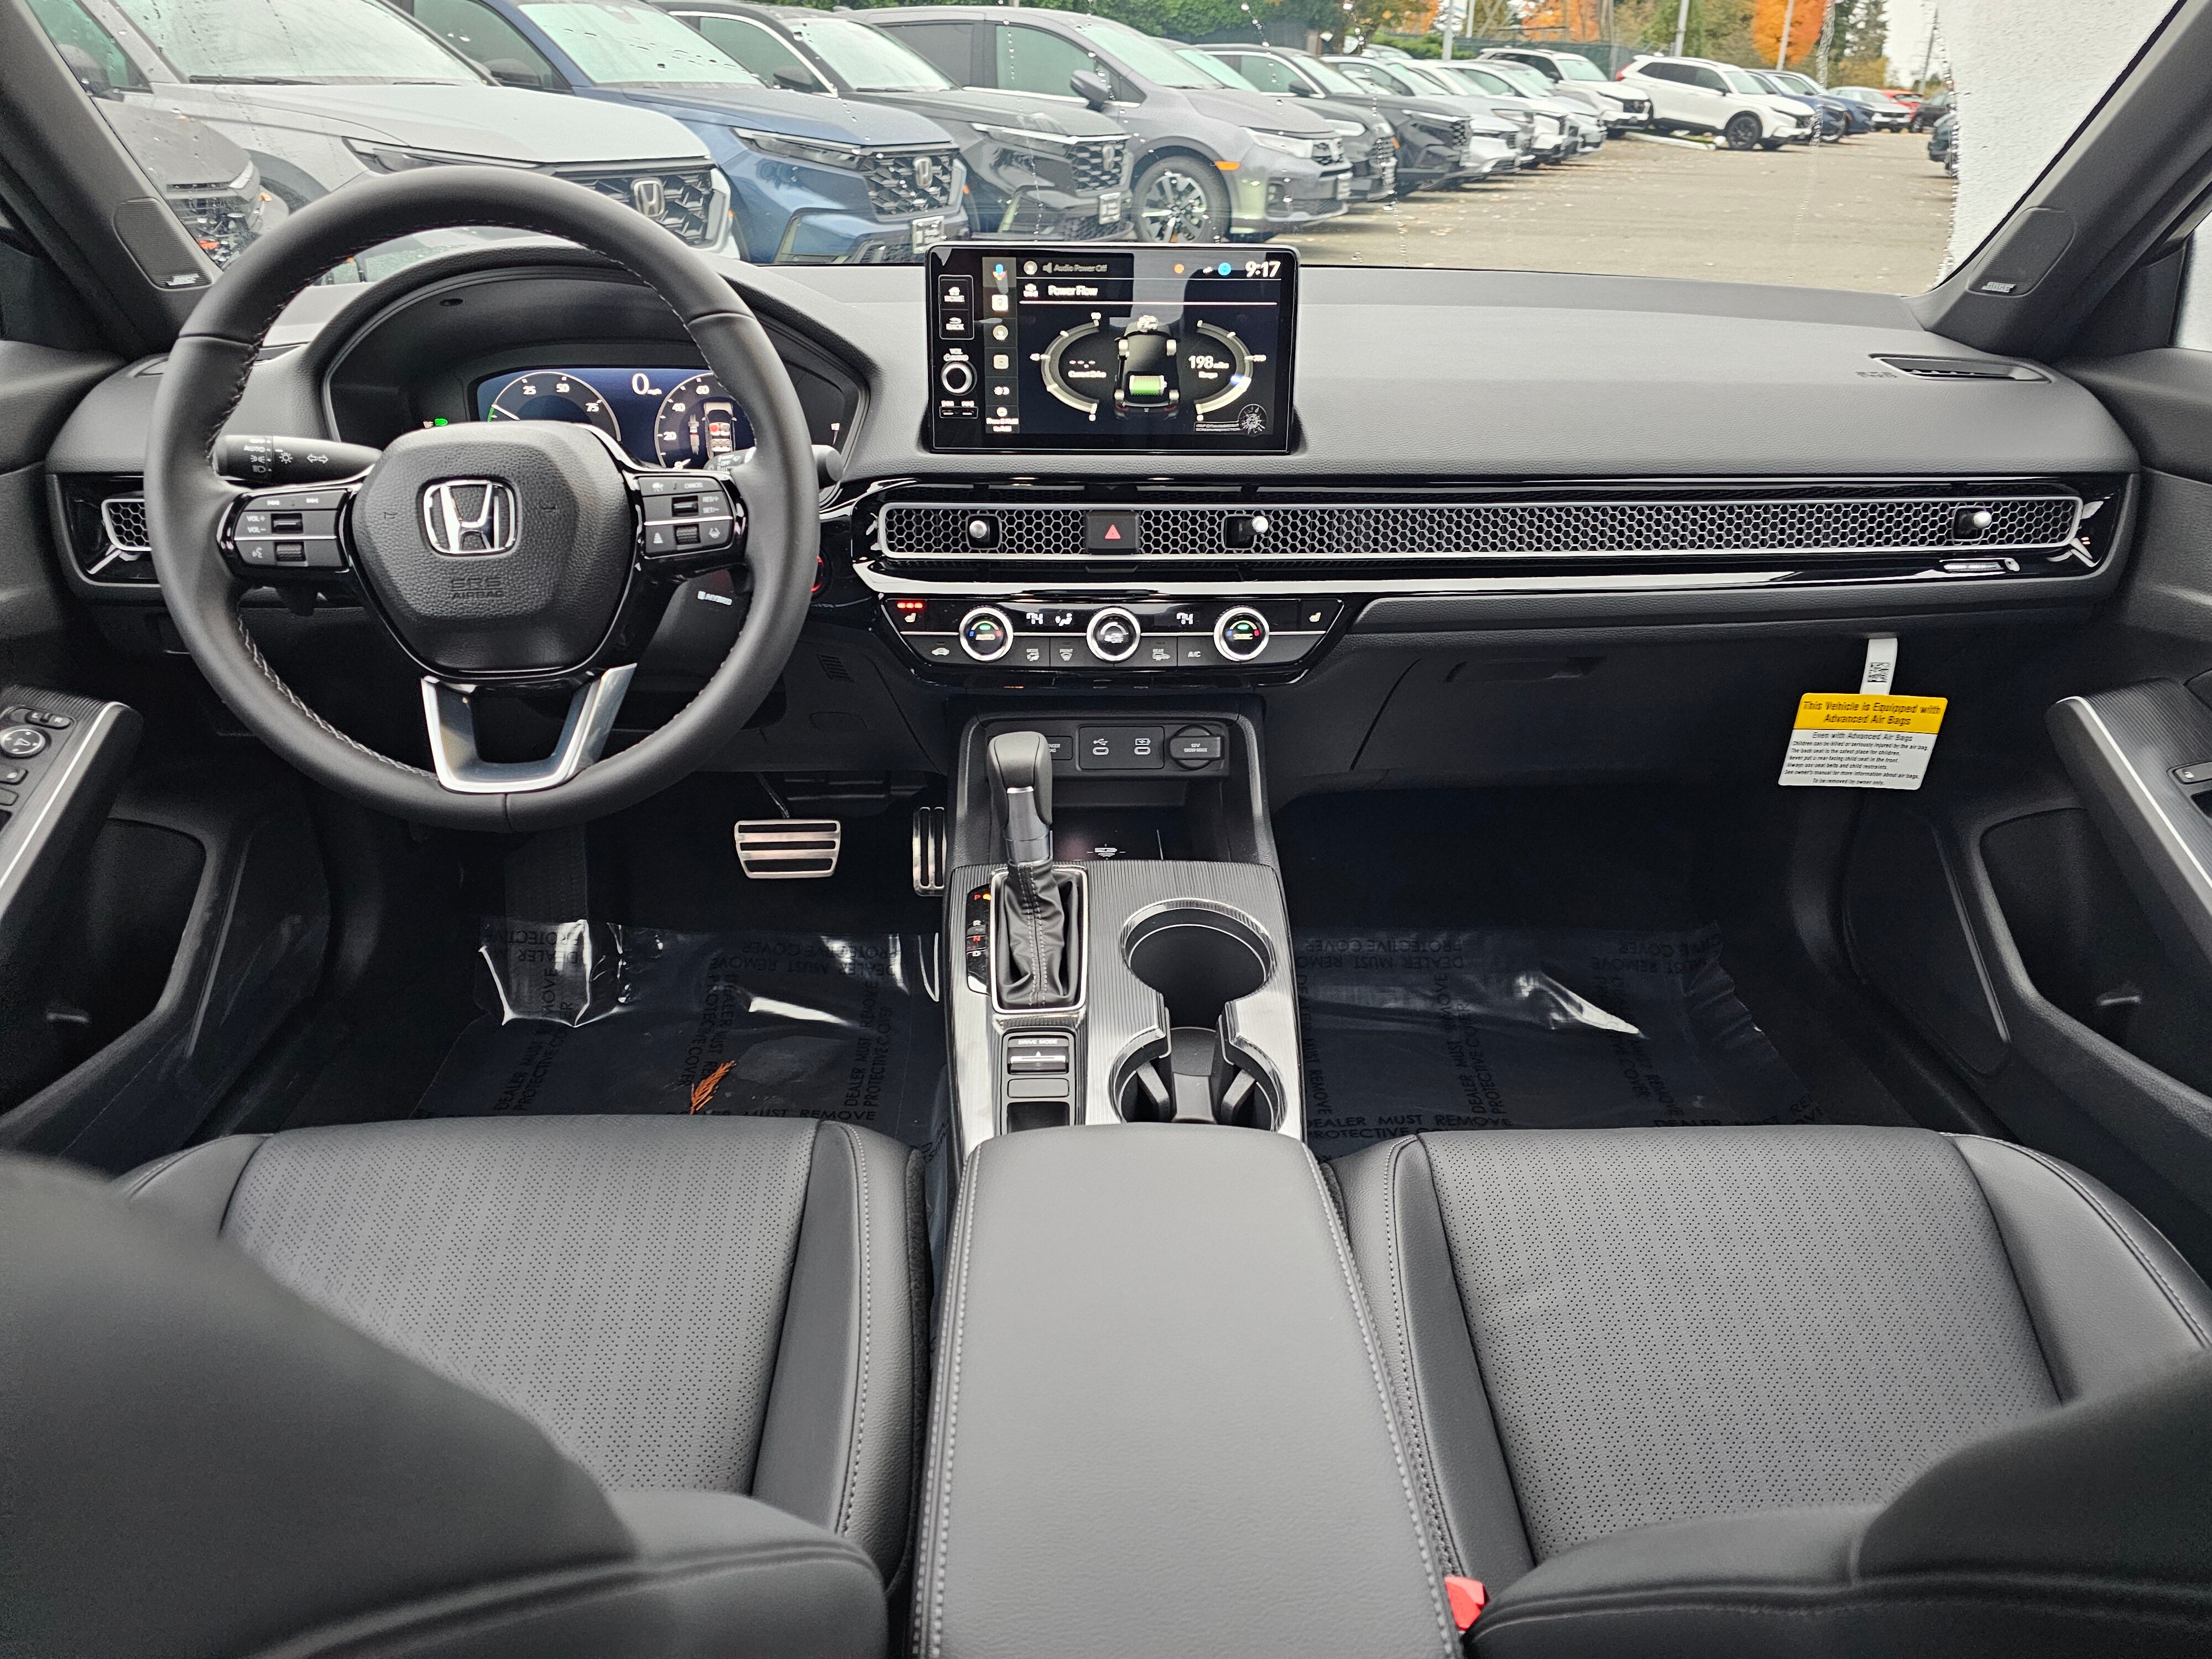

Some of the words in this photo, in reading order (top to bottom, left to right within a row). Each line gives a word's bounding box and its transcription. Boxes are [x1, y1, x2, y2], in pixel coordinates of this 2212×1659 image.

[1245, 260, 1281, 278] 9:17
[1048, 285, 1076, 295] Power
[1076, 285, 1098, 296] Flow
[1981, 281, 2016, 293] BOSE
[1188, 356, 1213, 369] 198
[523, 385, 536, 395] 25
[556, 383, 570, 393] 50
[632, 373, 649, 395] 0
[696, 385, 709, 395] 60
[585, 403, 599, 411] 75
[672, 403, 686, 411] 40
[664, 431, 677, 440] 20
[451, 578, 502, 588] SRS
[1803, 701, 1823, 710] This
[1825, 701, 1859, 711] Vehicle
[1861, 702, 1870, 711] is
[1873, 702, 1918, 714] Equipped
[1920, 705, 1942, 714] with
[1823, 714, 1869, 723] Advanced
[1870, 714, 1886, 724] Air
[1887, 716, 1911, 727] Bags
[518, 949, 578, 964] DEALER
[1296, 956, 1343, 969] REMO
[1353, 956, 1394, 969] MUST
[1406, 956, 1463, 969] DEALER
[854, 1035, 871, 1062] MUST
[1446, 1040, 1468, 1067] MUST
[862, 1046, 889, 1108] PROTECTIVE
[1469, 1050, 1507, 1114] PROTECTIVE
[843, 1067, 866, 1107] DEALER
[1308, 1070, 1333, 1115] REMOVE
[1458, 1074, 1487, 1114] DEALER
[800, 1108, 877, 1121] REMOVE
[1307, 1116, 1366, 1128] DEALER
[1378, 1114, 1424, 1126] MUST
[1435, 1115, 1515, 1128] REMOVE
